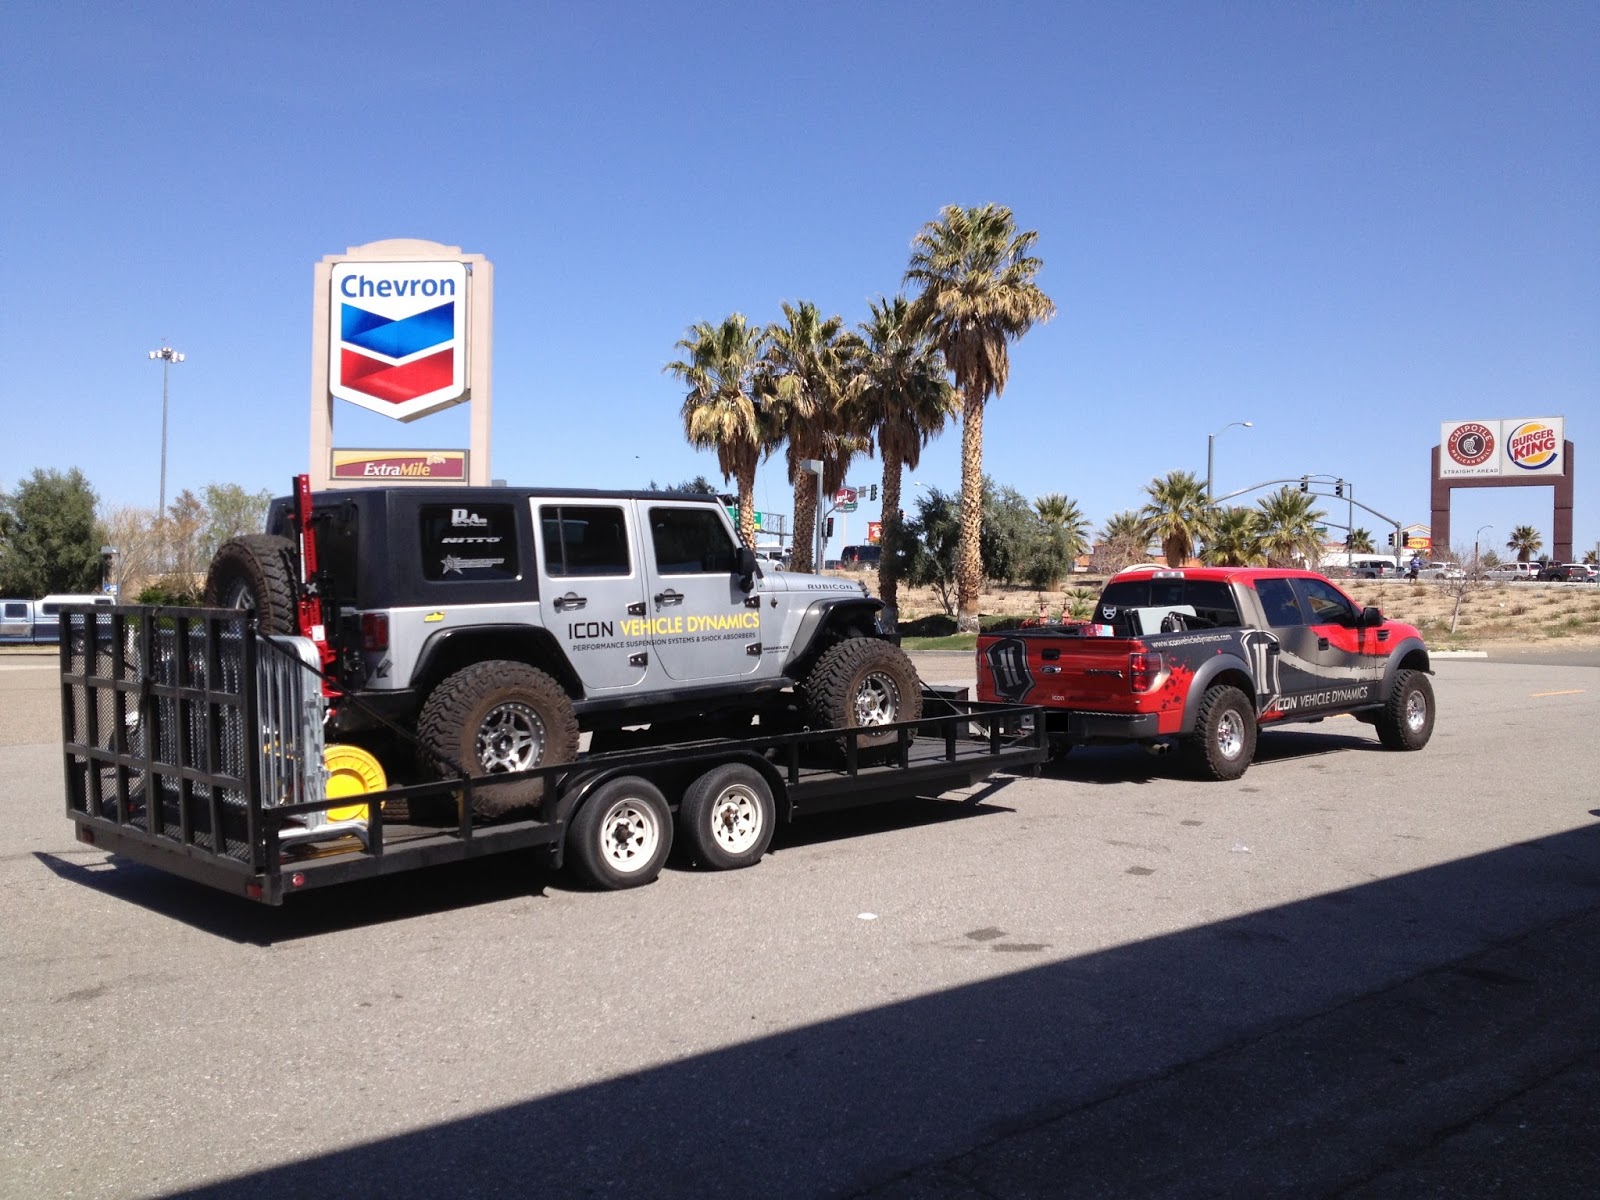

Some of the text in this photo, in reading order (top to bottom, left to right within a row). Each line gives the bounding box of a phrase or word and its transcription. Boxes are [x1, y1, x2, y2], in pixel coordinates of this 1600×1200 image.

[340, 274, 456, 298] Chevron
[1450, 425, 1493, 442] CHIPOTLE
[1512, 429, 1554, 449] BURGER
[1514, 437, 1556, 461] KING
[363, 462, 431, 477] ExtraMile
[568, 611, 760, 640] ICON VEHICLE DYNAMICS
[572, 641, 625, 652] PERFORMANCE
[625, 638, 667, 648] SUSPENSION
[668, 636, 695, 645] SYSTEMS
[701, 634, 722, 642] SHOCK
[722, 632, 756, 640] ABSORBERS
[1274, 686, 1368, 711] ICON VEHICLE DYNAMICS
